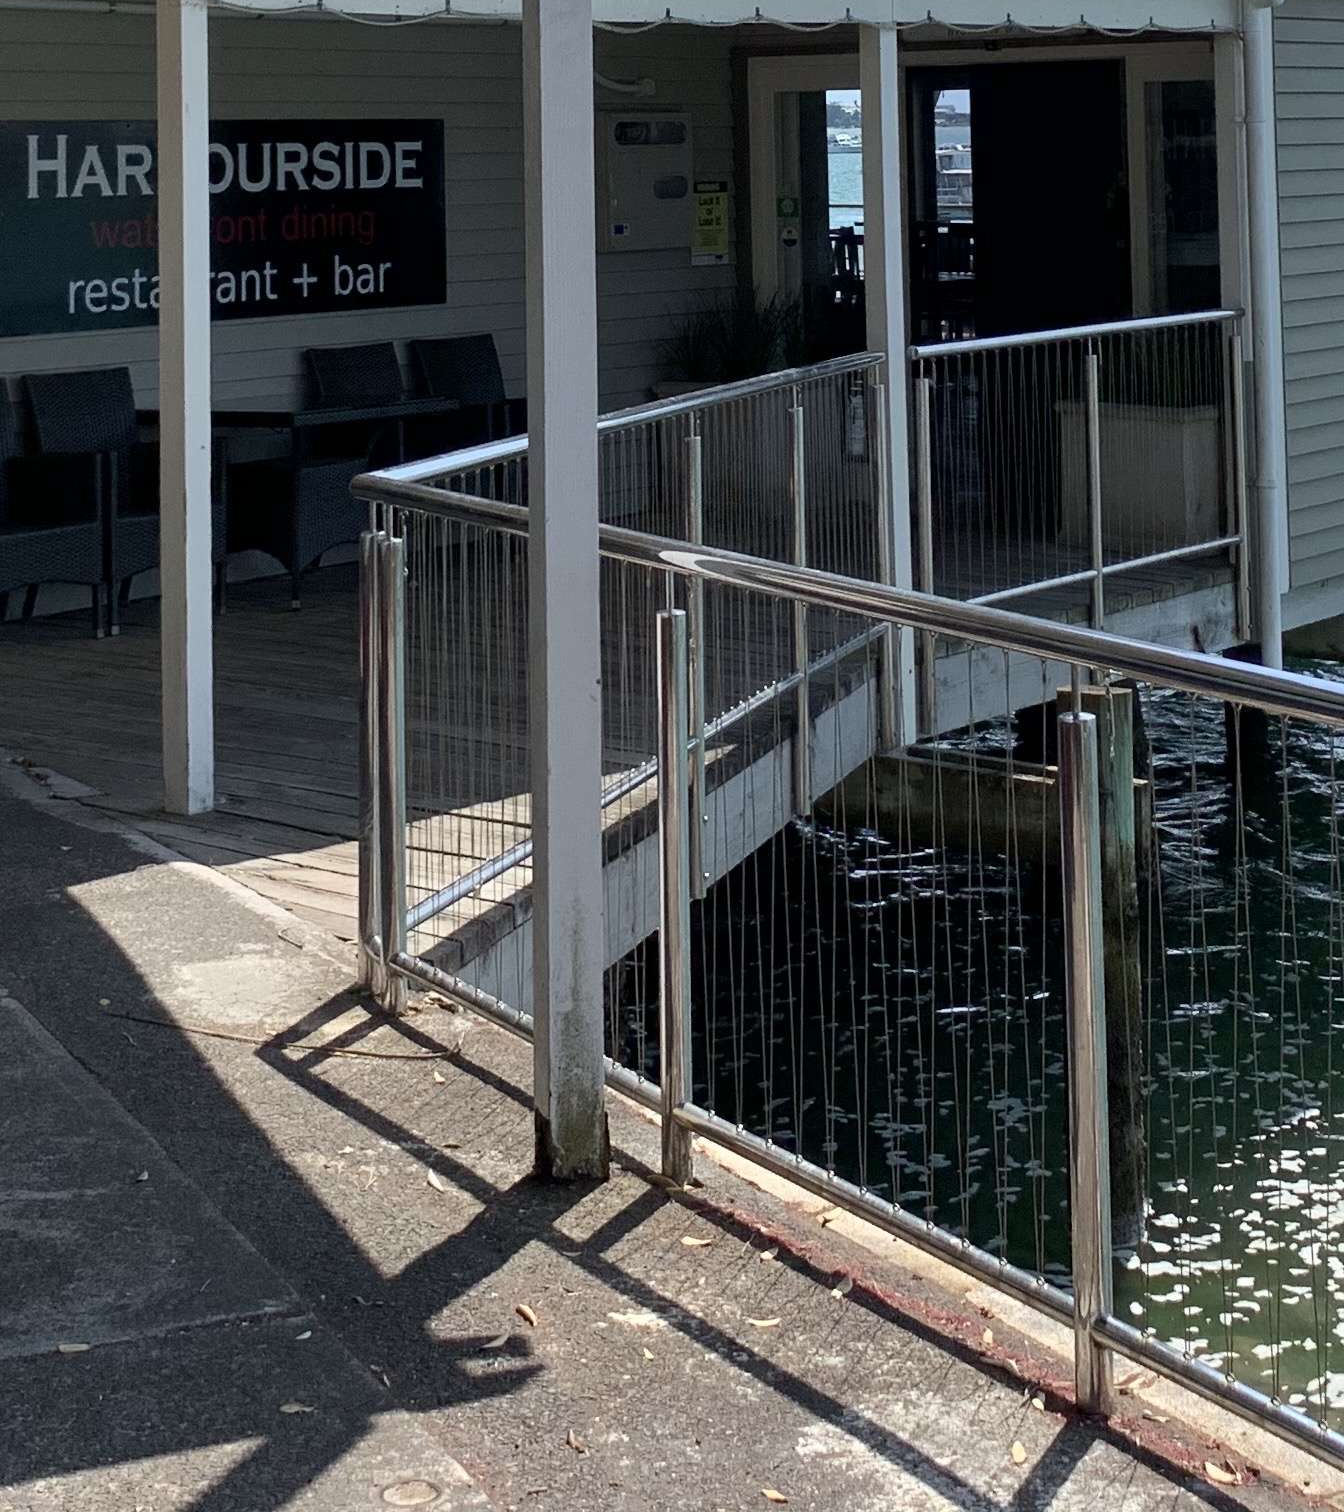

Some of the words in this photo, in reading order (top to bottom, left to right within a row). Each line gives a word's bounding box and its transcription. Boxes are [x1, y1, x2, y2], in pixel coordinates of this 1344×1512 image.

[26, 134, 424, 200] HAROURSIDE
[90, 212, 269, 250] watont
[281, 203, 377, 245] dining
[67, 260, 278, 315] restant
[333, 254, 392, 297] bar
